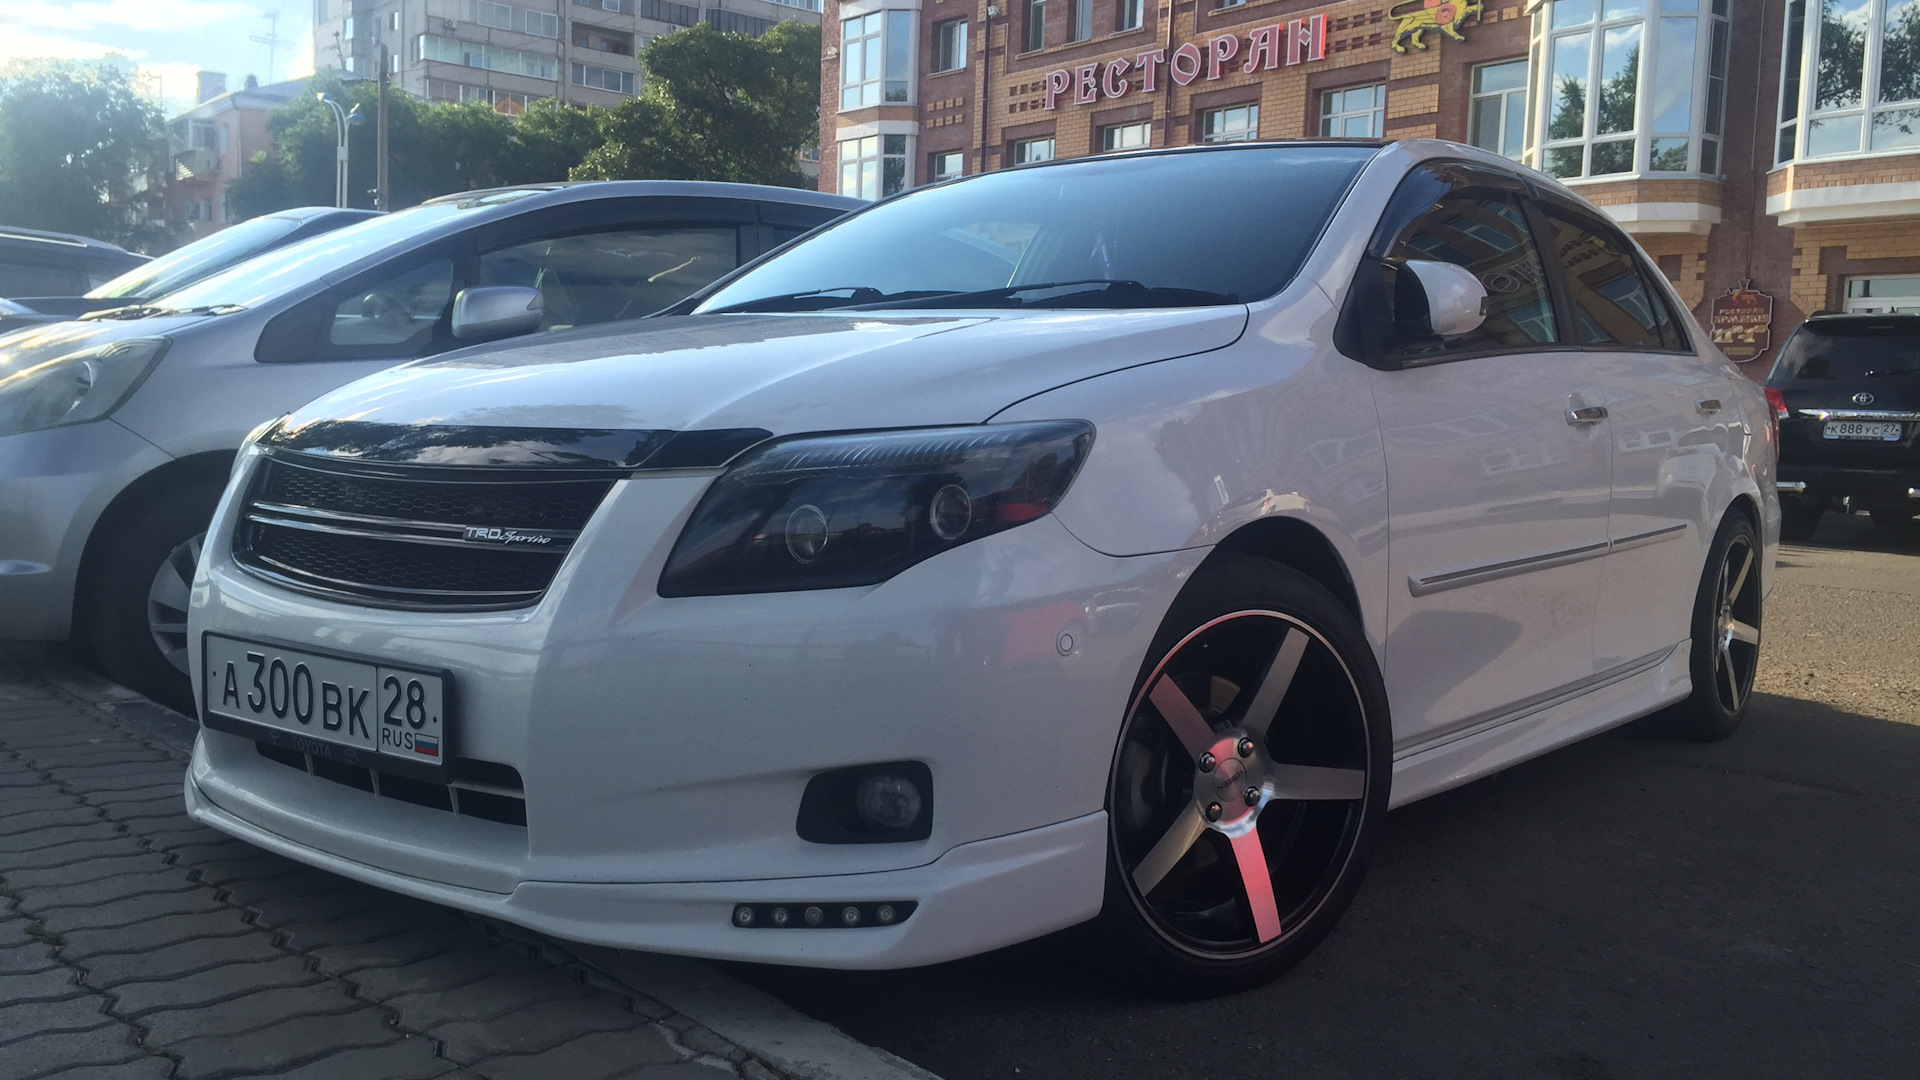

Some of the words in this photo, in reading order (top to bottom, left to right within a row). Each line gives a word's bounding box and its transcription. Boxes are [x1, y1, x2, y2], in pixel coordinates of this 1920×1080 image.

[1044, 14, 1327, 110] РЕСТОРАН
[1883, 425, 1896, 433] 27
[465, 527, 501, 539] TRD
[383, 675, 426, 730] 28
[292, 736, 333, 758] TOYOTA
[382, 727, 413, 750] RUS
